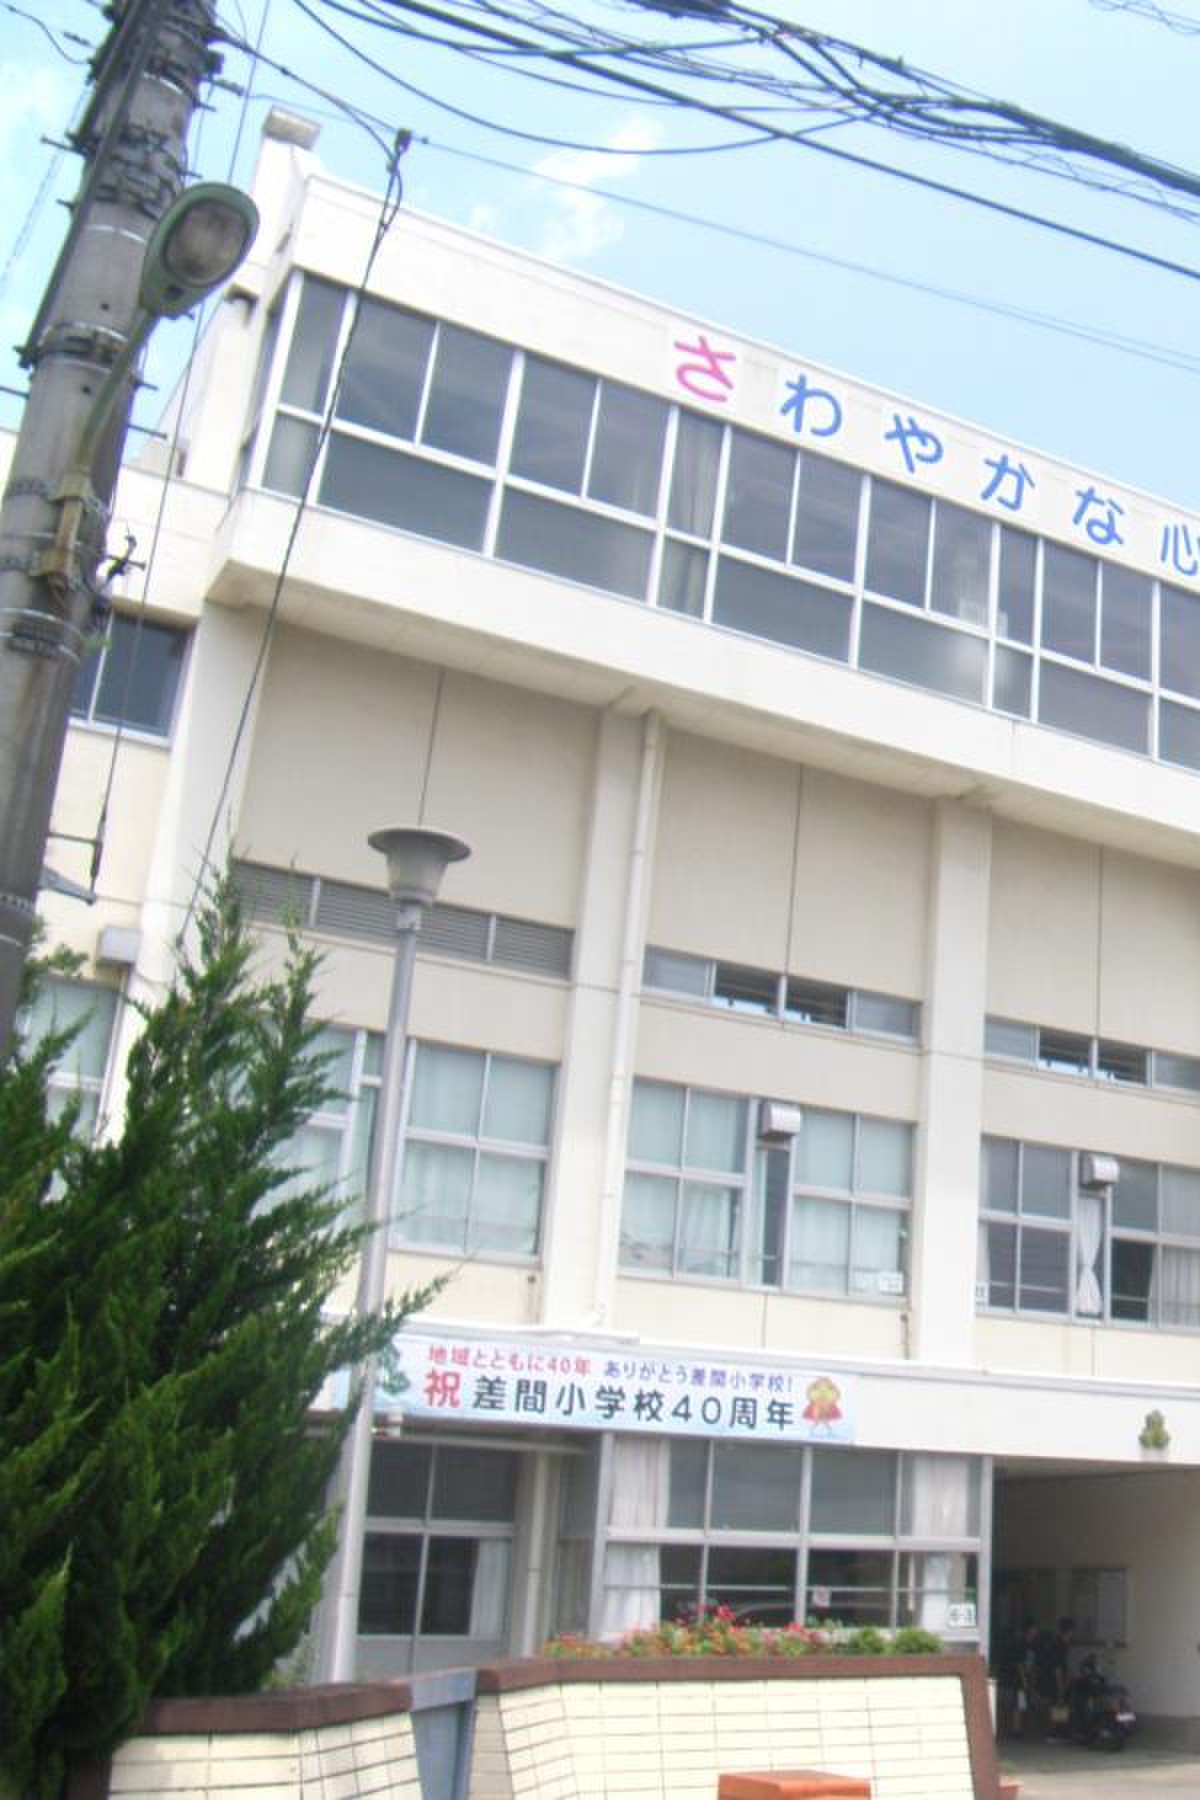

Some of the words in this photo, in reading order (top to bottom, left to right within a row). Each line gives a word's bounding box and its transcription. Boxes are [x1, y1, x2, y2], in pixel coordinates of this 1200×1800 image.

[428, 1343, 592, 1376] 地域とともに40年
[423, 1366, 462, 1408] 祝
[472, 1375, 795, 1431] 差間小学校40周年
